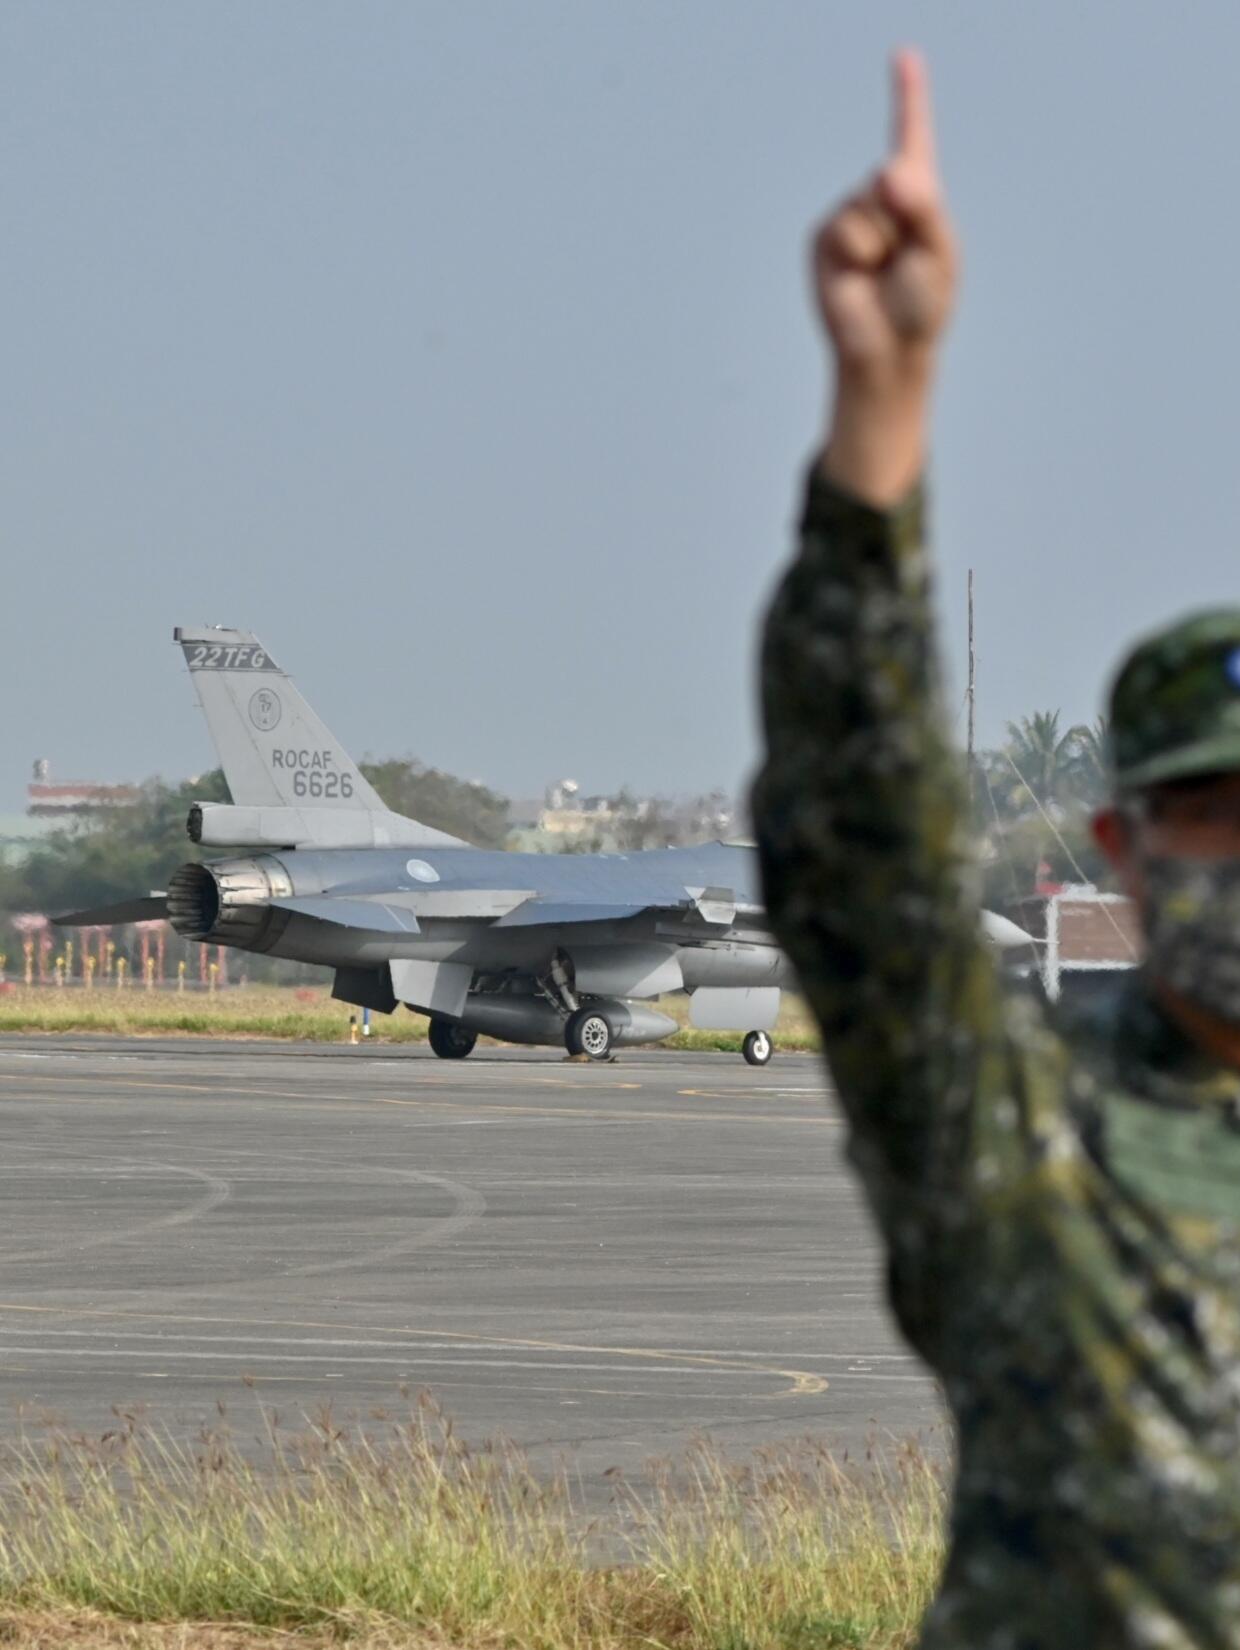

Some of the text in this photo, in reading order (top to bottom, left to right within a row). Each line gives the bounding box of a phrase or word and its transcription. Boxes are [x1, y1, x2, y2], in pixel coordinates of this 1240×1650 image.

[189, 646, 265, 668] 22TFG
[272, 749, 332, 769] ROCAF
[294, 770, 353, 798] 6626
